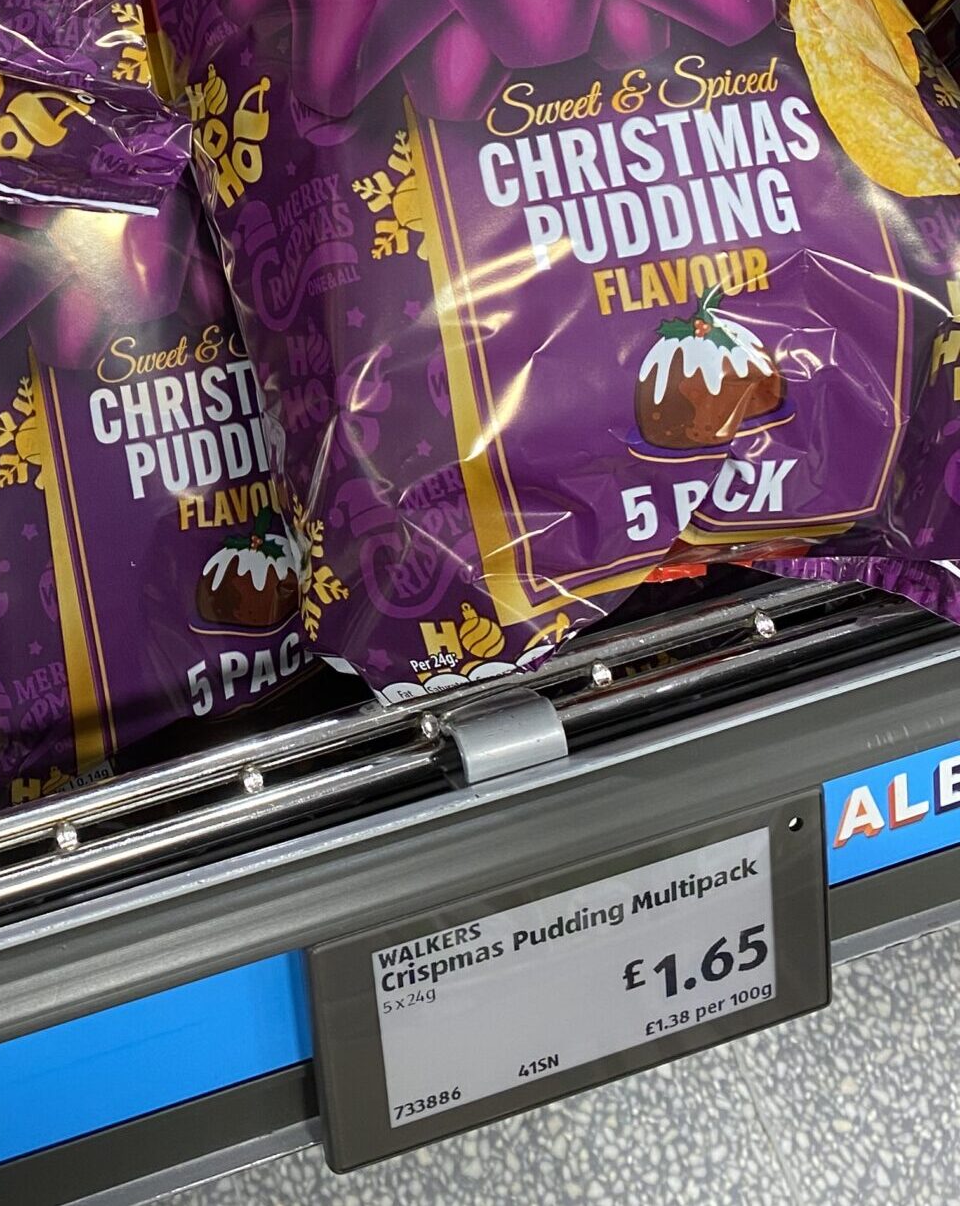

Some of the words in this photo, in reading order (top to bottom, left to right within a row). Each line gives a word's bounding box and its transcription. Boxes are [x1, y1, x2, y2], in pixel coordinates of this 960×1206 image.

[486, 82, 603, 137] Sweet
[611, 69, 651, 114] &
[658, 55, 778, 114] Spiced
[478, 96, 821, 208] CHRISTMAS
[523, 168, 801, 271] PUDDING
[593, 246, 769, 315] FLAVOUR
[98, 335, 188, 385] Sweet
[194, 324, 226, 361] &
[621, 484, 657, 543] 5
[677, 458, 798, 530] PCK
[186, 658, 208, 719] 5
[410, 658, 431, 672] Per
[378, 923, 482, 969] WALKERS
[381, 941, 504, 992] Crispmas
[512, 901, 625, 952] Pudding
[631, 857, 758, 916] Multipack
[645, 1008, 690, 1037] £1.38
[694, 998, 726, 1022] per
[730, 982, 773, 1008] 100g
[393, 1086, 462, 1121] 733886
